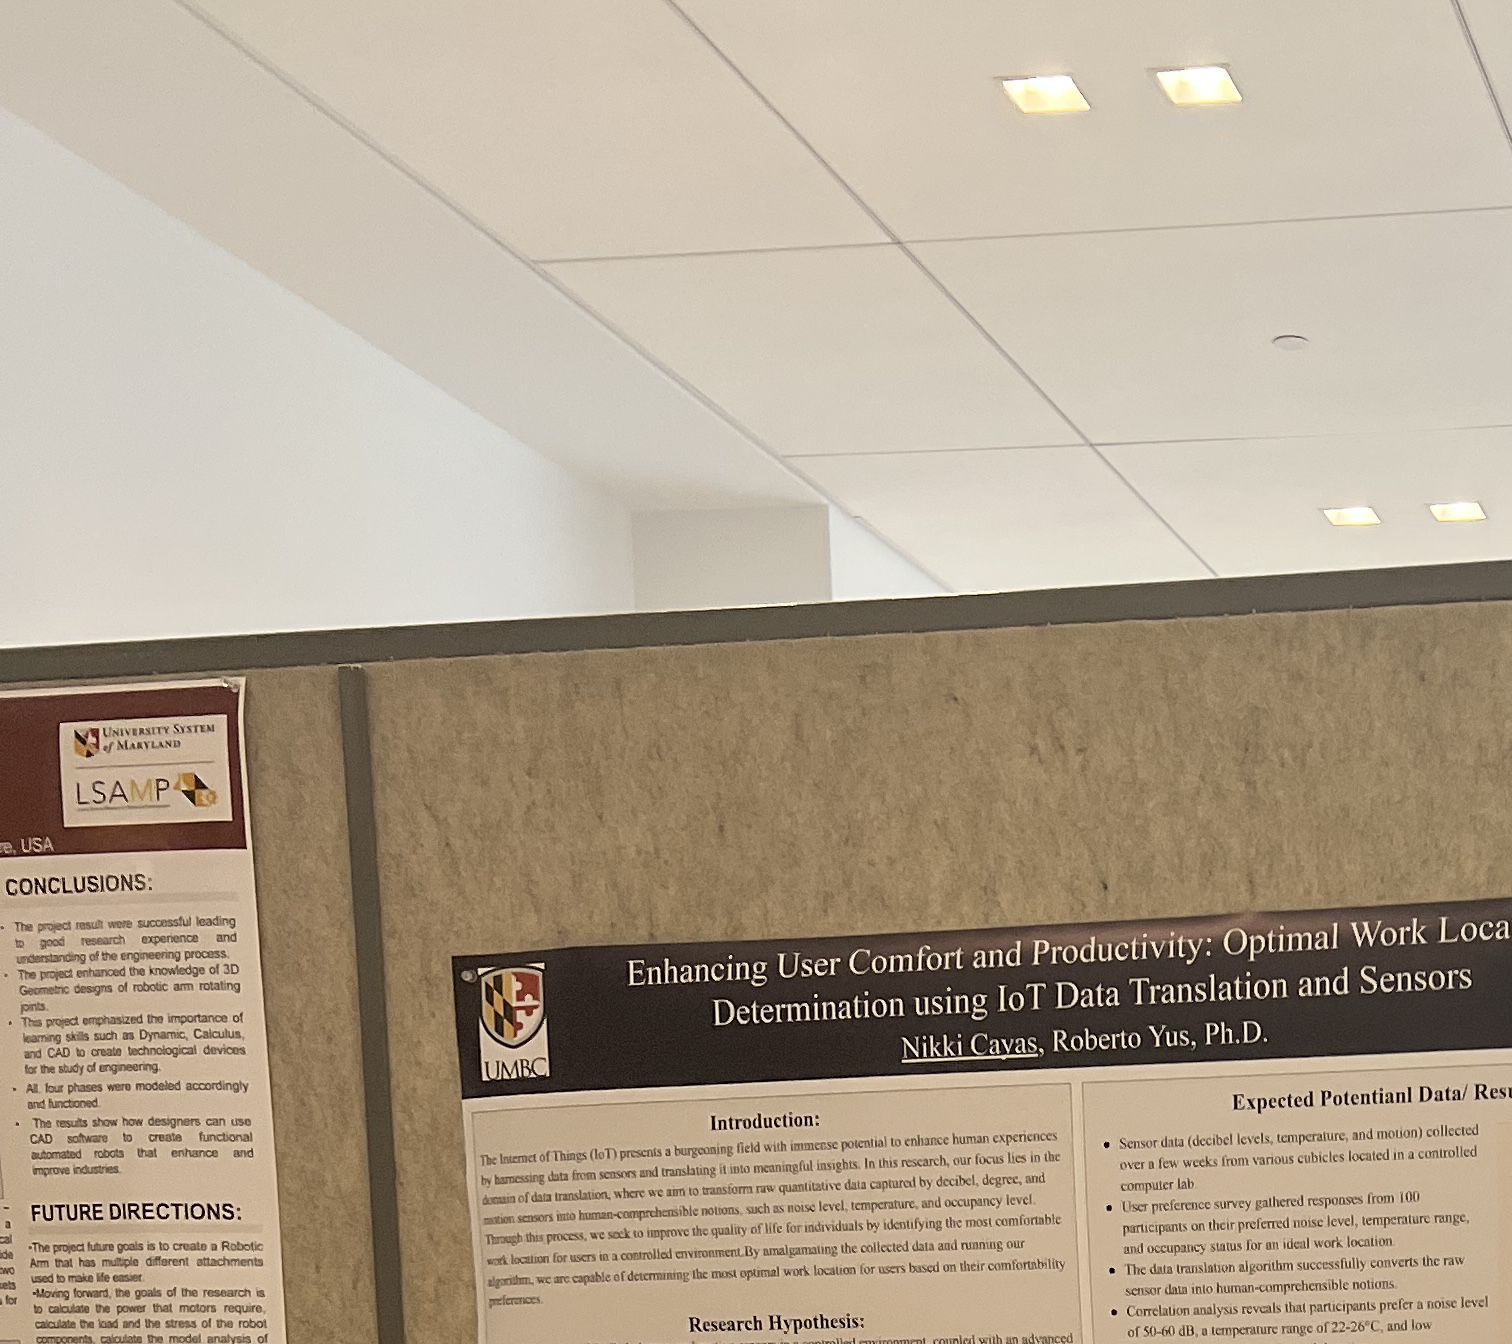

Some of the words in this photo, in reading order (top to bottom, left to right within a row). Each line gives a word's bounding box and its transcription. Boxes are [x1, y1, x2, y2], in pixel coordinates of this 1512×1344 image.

[103, 726, 170, 738] UNIVERSITY
[173, 723, 215, 734] SYSTEM
[103, 742, 114, 753] of
[117, 739, 181, 751] MARYLAND
[76, 778, 170, 805] LSAMP
[20, 836, 55, 853] USA
[5, 873, 153, 896] CONCLUSIONS:
[627, 955, 768, 986] Enhancing
[777, 952, 841, 978] User
[848, 945, 964, 974] Comfort
[972, 940, 1021, 968] and
[1031, 932, 1212, 965] Productivity:
[1223, 923, 1338, 961] Optimal
[1350, 918, 1428, 947] Work
[16, 968, 37, 980] The
[75, 965, 126, 978] enhanced
[128, 965, 146, 977] the
[148, 964, 206, 978] knowledge
[208, 963, 220, 975] of
[222, 962, 240, 975] 3D
[712, 992, 905, 1025] Determination
[914, 987, 988, 1020] using
[997, 982, 1046, 1012] IoT
[1054, 981, 1120, 1009] Data
[1128, 972, 1288, 1005] Translation
[1298, 966, 1349, 997] and
[1360, 965, 1472, 994] Sensors
[901, 1033, 963, 1060] Nikki
[1052, 1028, 1142, 1052] Roberto
[1149, 1024, 1197, 1049] Yus,
[1204, 1020, 1268, 1046] Ph.D.
[484, 1057, 547, 1081] UMBC
[44, 1082, 64, 1094] four
[66, 1082, 103, 1095] phases
[105, 1083, 132, 1092] were
[134, 1080, 182, 1091] modeled
[184, 1080, 249, 1094] accordingly
[1232, 1090, 1314, 1114] Expected
[1419, 1085, 1468, 1102] Data/
[710, 1112, 820, 1131] Introduction:
[1119, 1137, 1158, 1150] Sensor
[1160, 1135, 1185, 1148] data
[1187, 1133, 1233, 1149] (decibel
[1236, 1132, 1274, 1145] levels,
[1276, 1131, 1349, 1145] temperature,
[1351, 1127, 1374, 1141] and
[1376, 1126, 1423, 1140] motion)
[1425, 1123, 1479, 1138] collected
[30, 1203, 104, 1221] FUTURE
[108, 1202, 242, 1220] DIRECTIONS:
[688, 1315, 763, 1332] Research
[767, 1313, 864, 1334] Hypothesis:
[1127, 1325, 1141, 1338] of
[1143, 1325, 1176, 1337] 50-60
[1201, 1327, 1208, 1337] a
[1211, 1325, 1278, 1338] temperature
[1280, 1324, 1313, 1337] range
[1315, 1320, 1330, 1334] of
[1386, 1319, 1408, 1332] and
[1411, 1318, 1432, 1331] low
